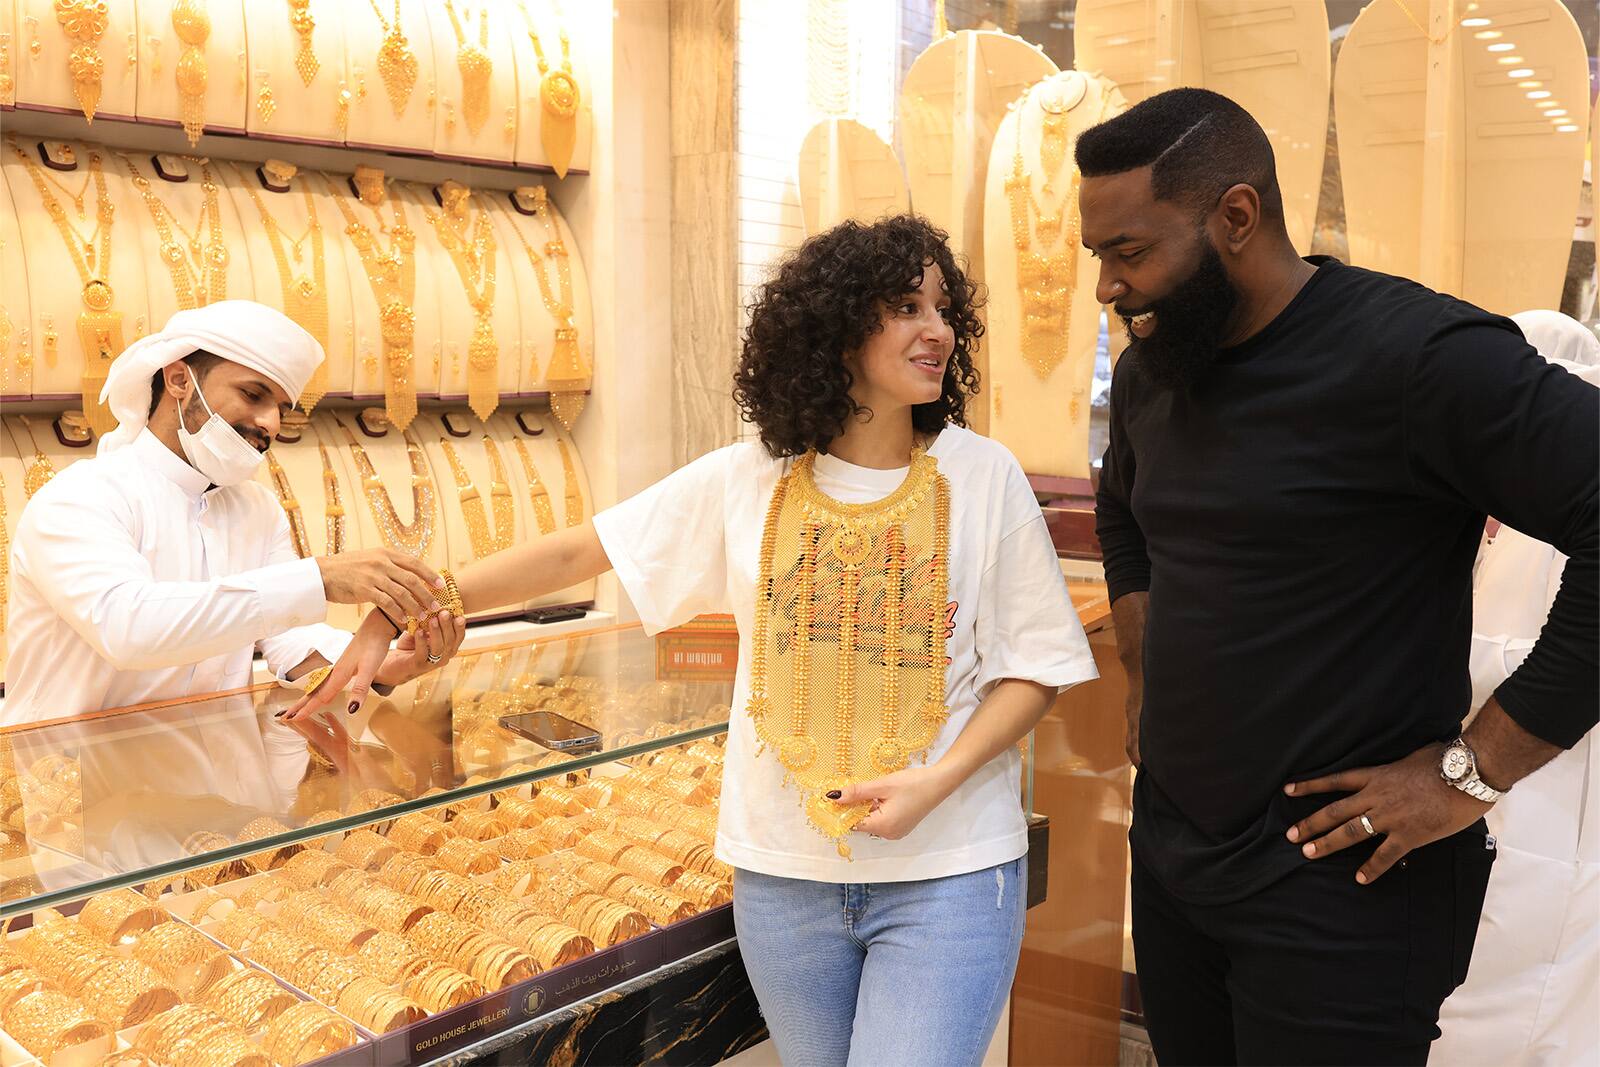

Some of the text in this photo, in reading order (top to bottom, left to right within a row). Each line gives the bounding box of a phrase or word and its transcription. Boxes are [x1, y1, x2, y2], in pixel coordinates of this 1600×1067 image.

[555, 959, 636, 997] مجوهرات بيت الذهب
[415, 1006, 512, 1052] GOLD HOUSE JEWELLERY
